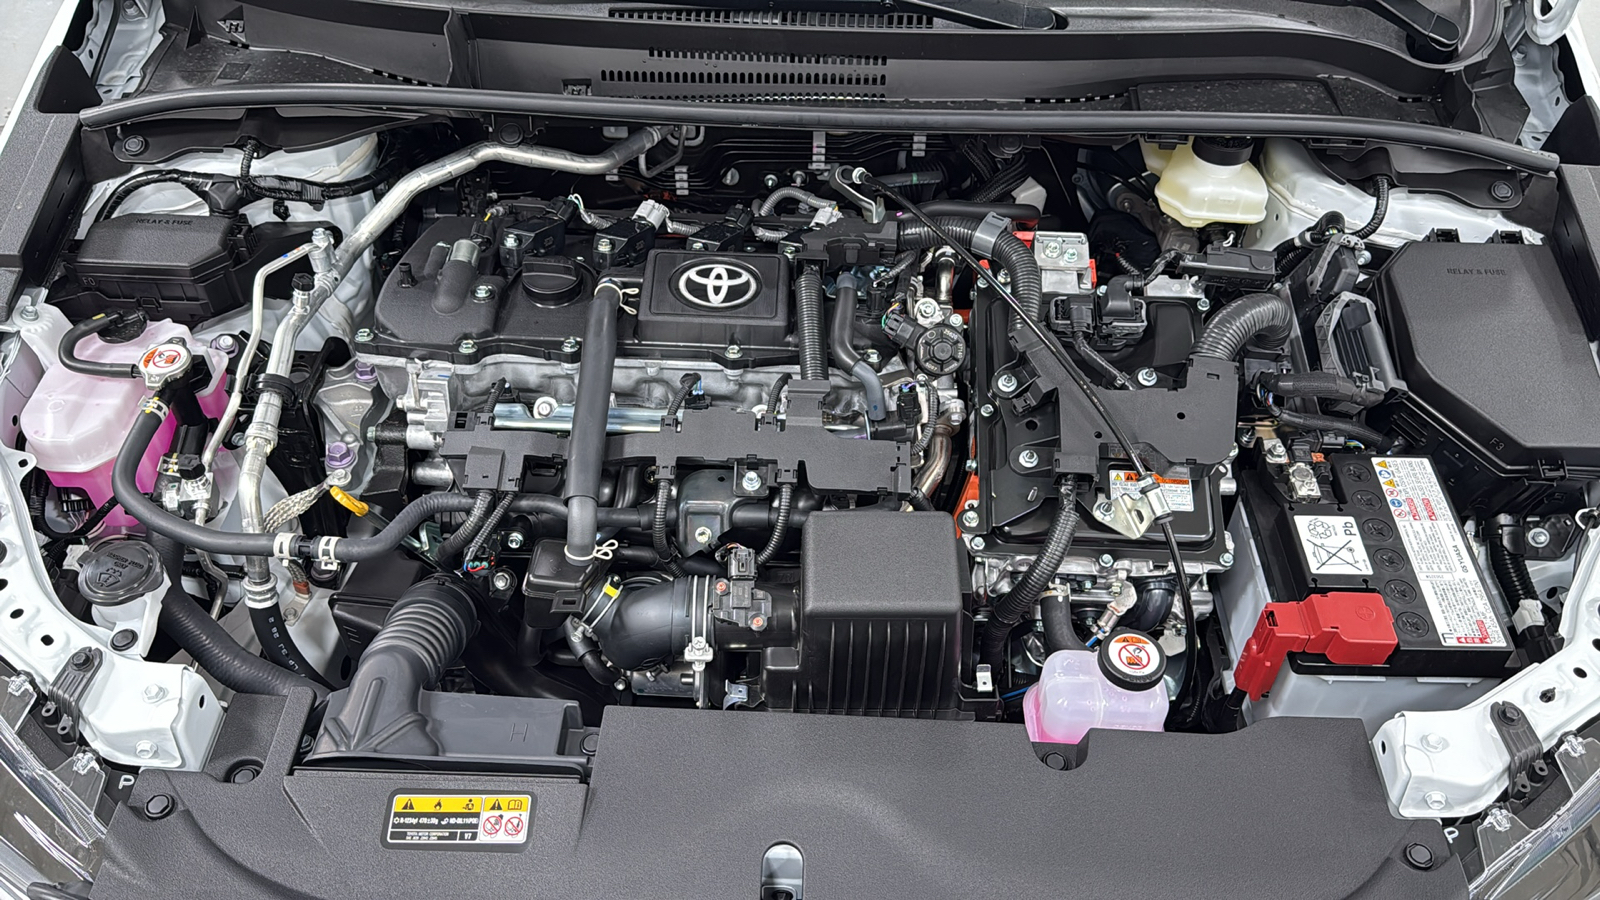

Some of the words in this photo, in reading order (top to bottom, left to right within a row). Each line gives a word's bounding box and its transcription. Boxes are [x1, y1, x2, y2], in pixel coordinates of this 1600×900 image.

[1484, 268, 1507, 276] FUSE
[1489, 436, 1505, 451] F3
[1342, 521, 1357, 536] Pb
[1451, 544, 1465, 564] YUASA
[510, 722, 529, 743] H
[118, 774, 135, 790] P
[1443, 826, 1459, 844] P
